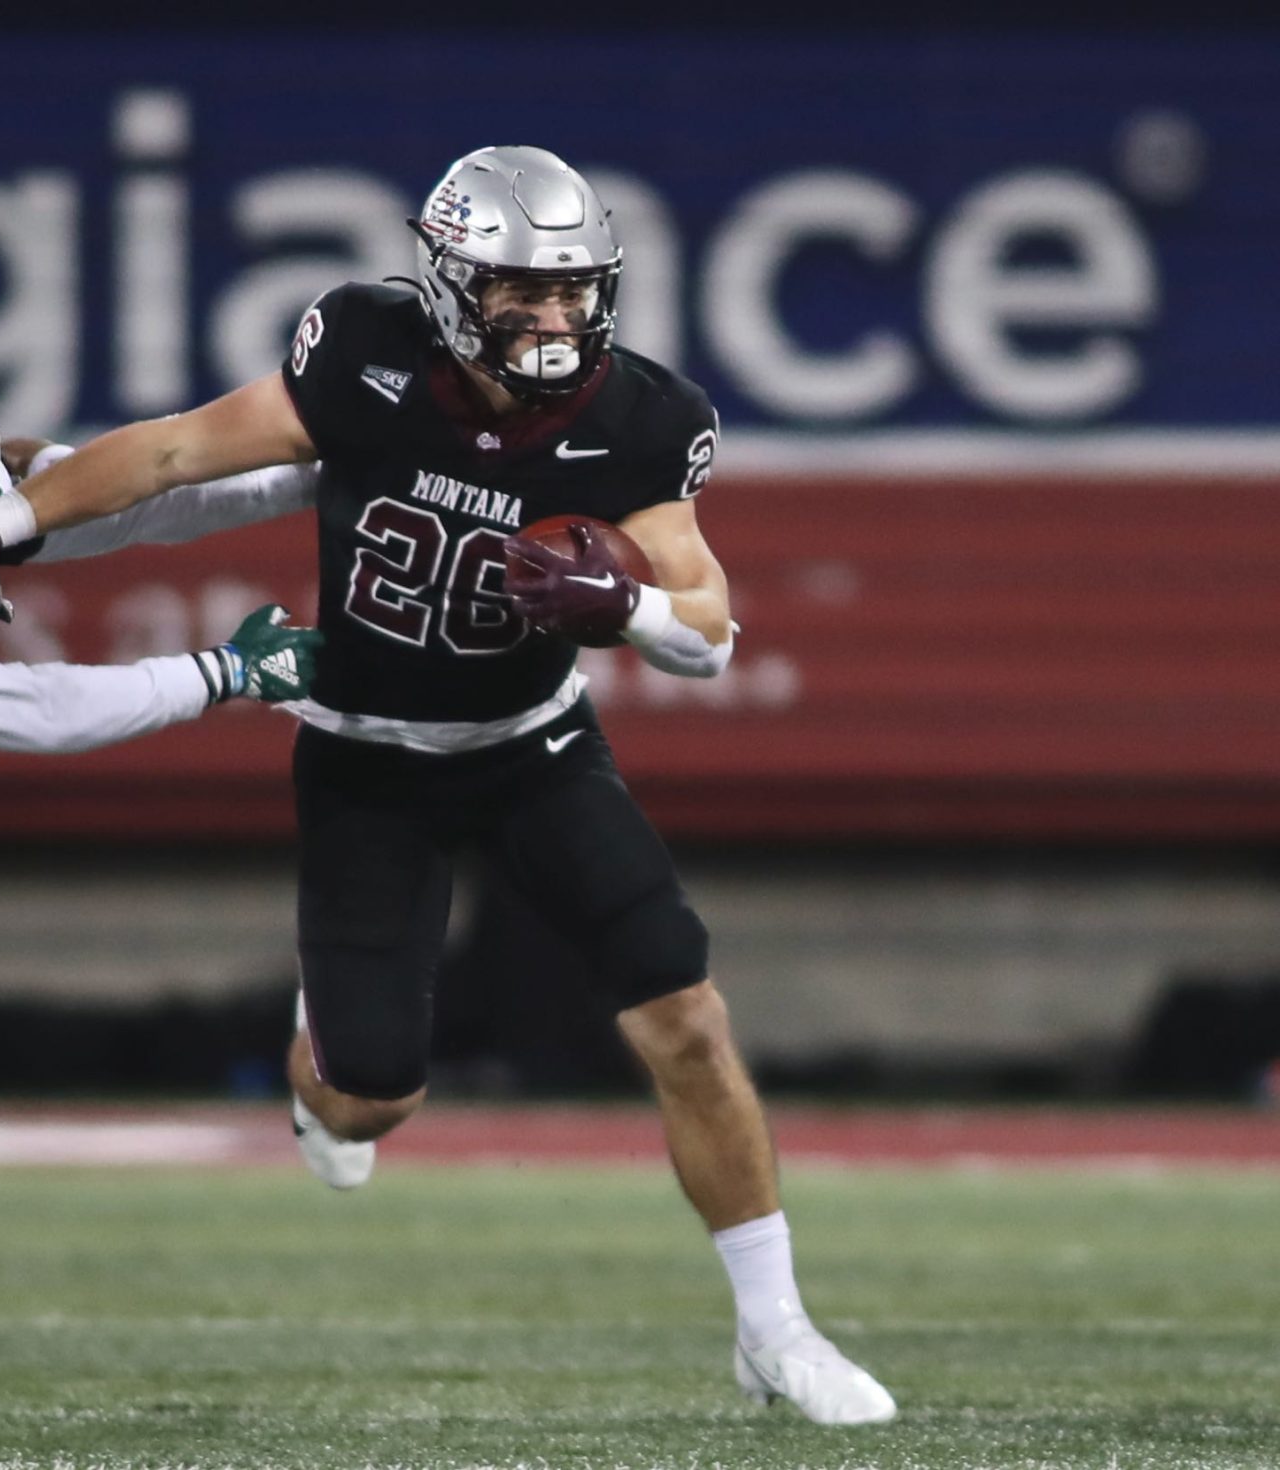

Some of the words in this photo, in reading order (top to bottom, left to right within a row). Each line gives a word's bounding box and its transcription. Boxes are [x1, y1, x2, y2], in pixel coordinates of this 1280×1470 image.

[411, 470, 522, 527] MONTANA
[344, 496, 530, 655] 26
[260, 659, 300, 687] adidas
